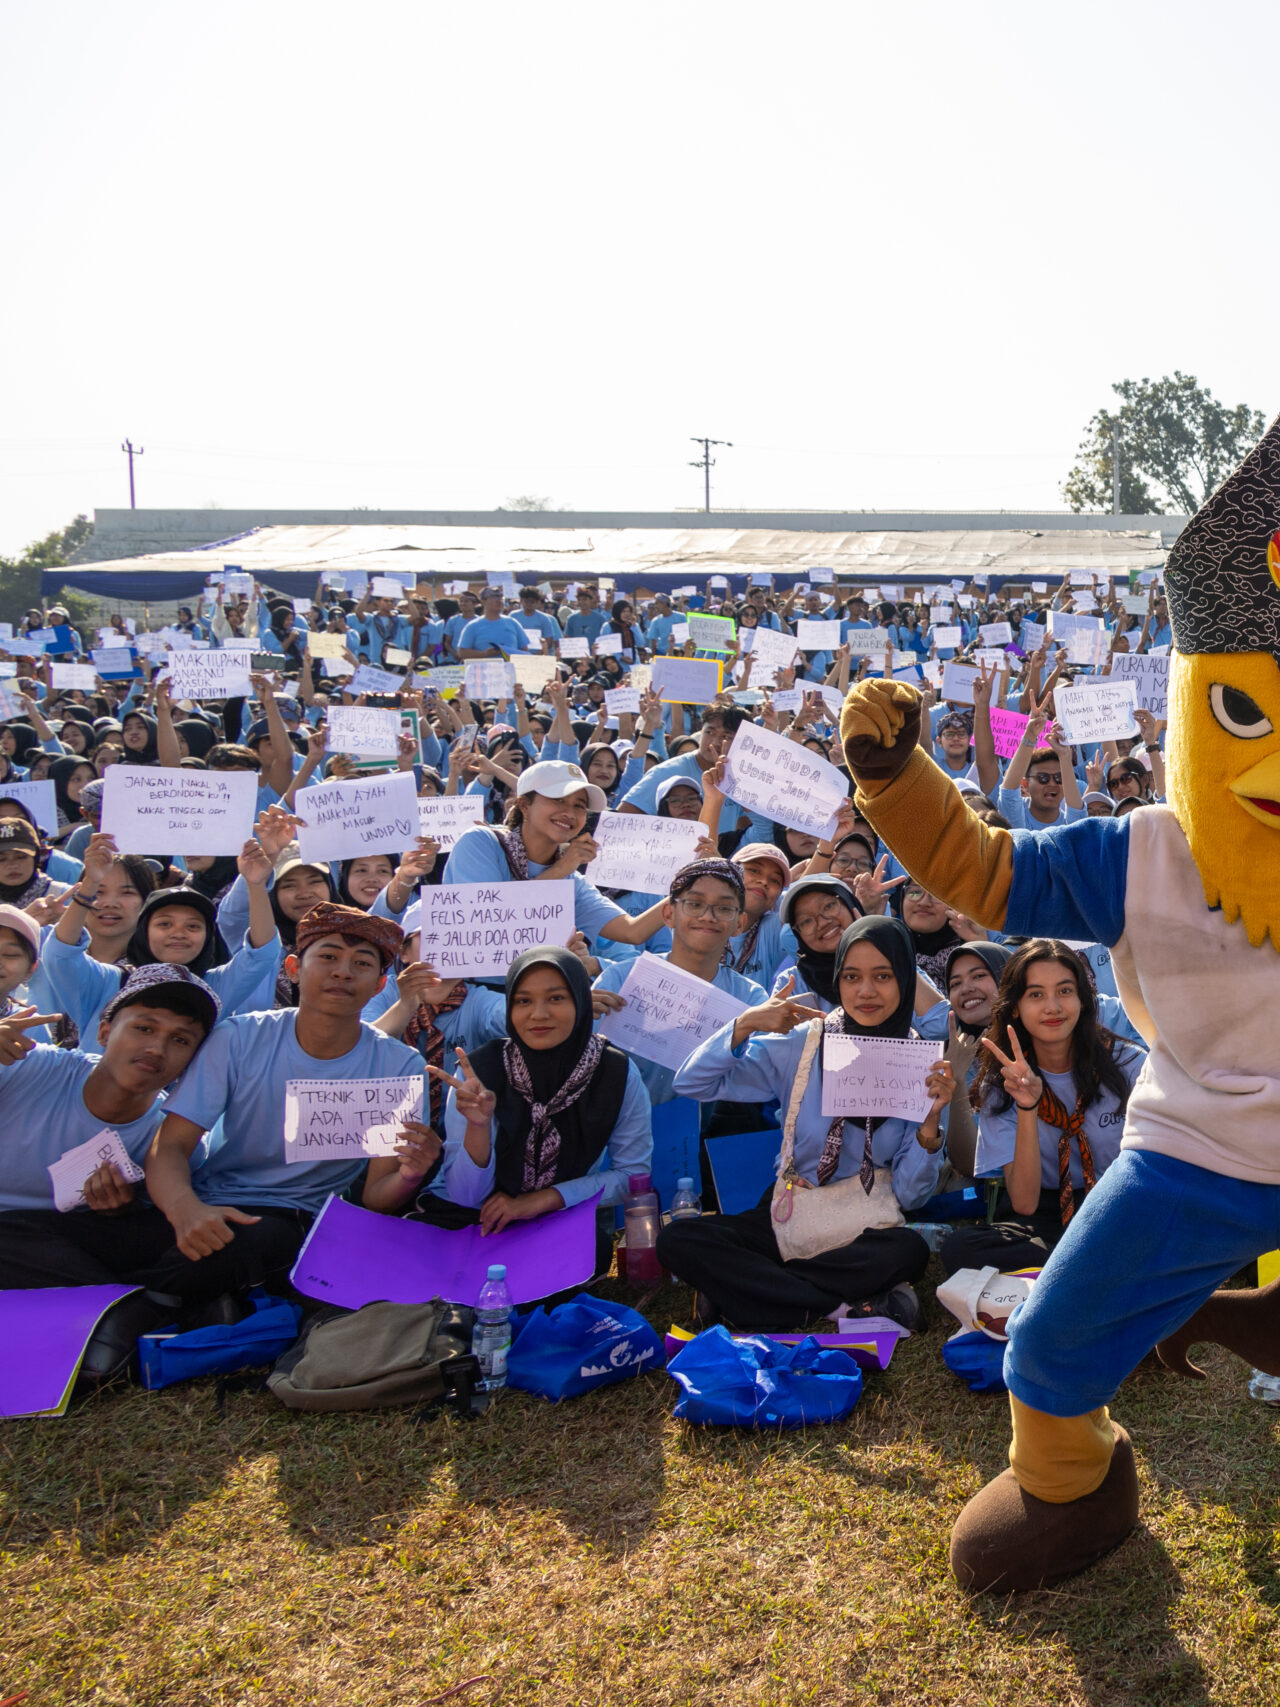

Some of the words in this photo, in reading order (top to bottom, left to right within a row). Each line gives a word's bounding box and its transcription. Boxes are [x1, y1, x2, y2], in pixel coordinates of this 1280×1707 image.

[175, 654, 204, 667] MAK
[1145, 659, 1168, 675] AKU
[173, 668, 224, 679] ANAKMU
[173, 679, 212, 688] MASUK
[181, 688, 227, 699] UNDIP!!
[125, 776, 173, 789] JANGAN
[181, 777, 211, 789] NAKAL
[306, 790, 344, 810] MAMA
[354, 787, 386, 803] AYAH
[137, 806, 165, 816] KAKAK
[168, 806, 206, 816] TINGGAL
[317, 806, 360, 825] ANAKMU
[361, 825, 396, 843] UNDIP
[432, 891, 462, 906] MAK
[431, 910, 465, 926] FELIS
[470, 907, 518, 925] MASUK
[524, 903, 564, 921] UNDIP
[485, 929, 510, 944] DOA
[513, 927, 547, 944] ORTU
[658, 978, 679, 995] IBU
[628, 994, 673, 1021] TEKNIK
[675, 1019, 704, 1039] SIPIL
[679, 1003, 714, 1025] MASUK
[301, 1090, 355, 1104] TEKNIK
[365, 1089, 380, 1104] DI
[385, 1088, 416, 1104] SINI
[310, 1110, 344, 1127] ADA
[355, 1109, 422, 1127] TEKNIK
[298, 1131, 370, 1147] JANGAN
[995, 1294, 1018, 1304] are
